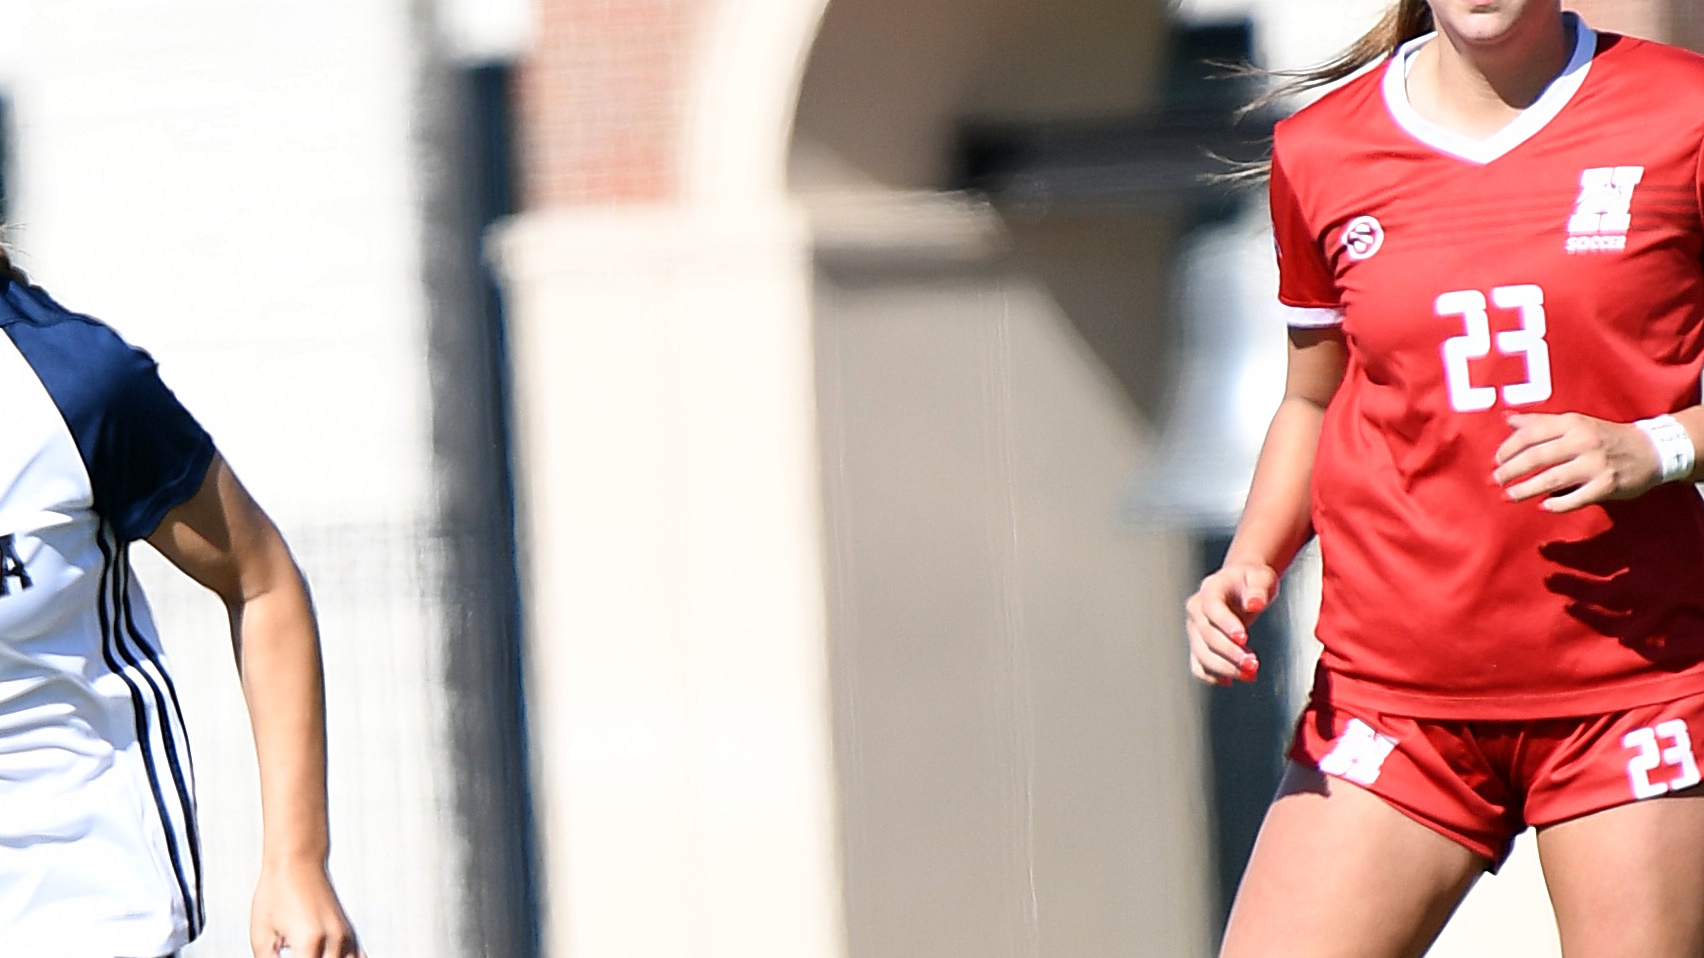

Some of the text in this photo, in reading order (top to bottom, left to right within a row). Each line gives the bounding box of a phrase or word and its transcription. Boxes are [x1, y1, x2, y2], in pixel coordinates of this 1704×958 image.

[1565, 235, 1627, 253] SOCCER
[1434, 284, 1553, 412] 23
[1622, 718, 1701, 799] 23
